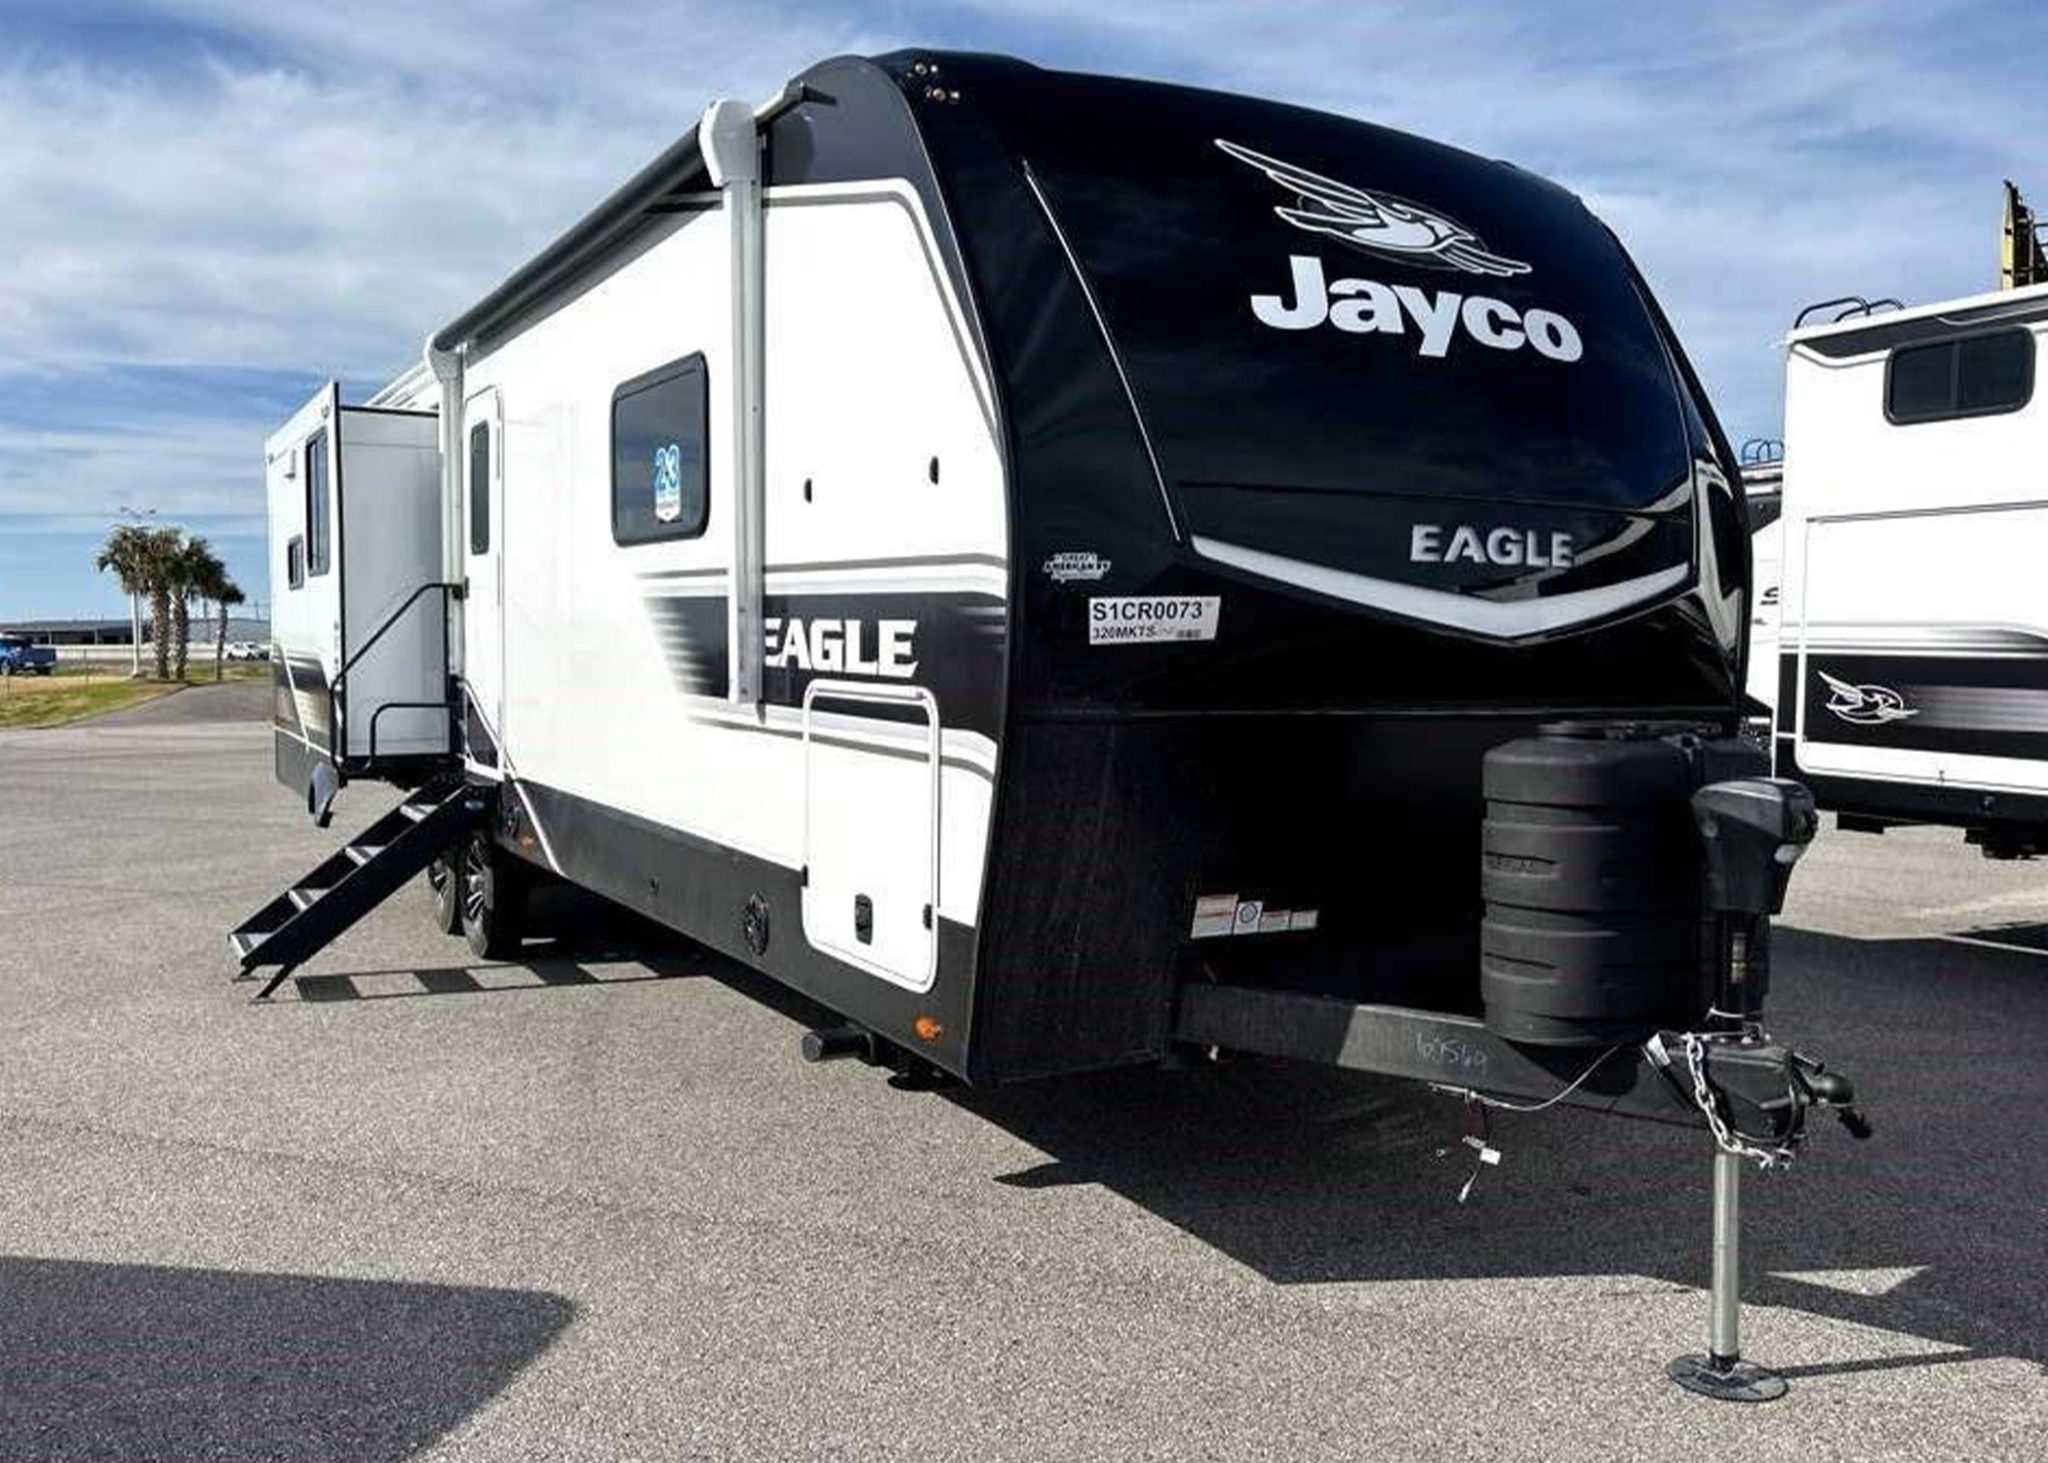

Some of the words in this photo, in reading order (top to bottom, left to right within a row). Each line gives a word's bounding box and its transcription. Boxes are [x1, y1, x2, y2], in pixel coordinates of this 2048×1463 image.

[1251, 255, 1583, 363] Jayco
[1410, 524, 1575, 568] EAGLE
[1093, 601, 1203, 621] S1CR0073
[765, 618, 919, 678] EAGLE
